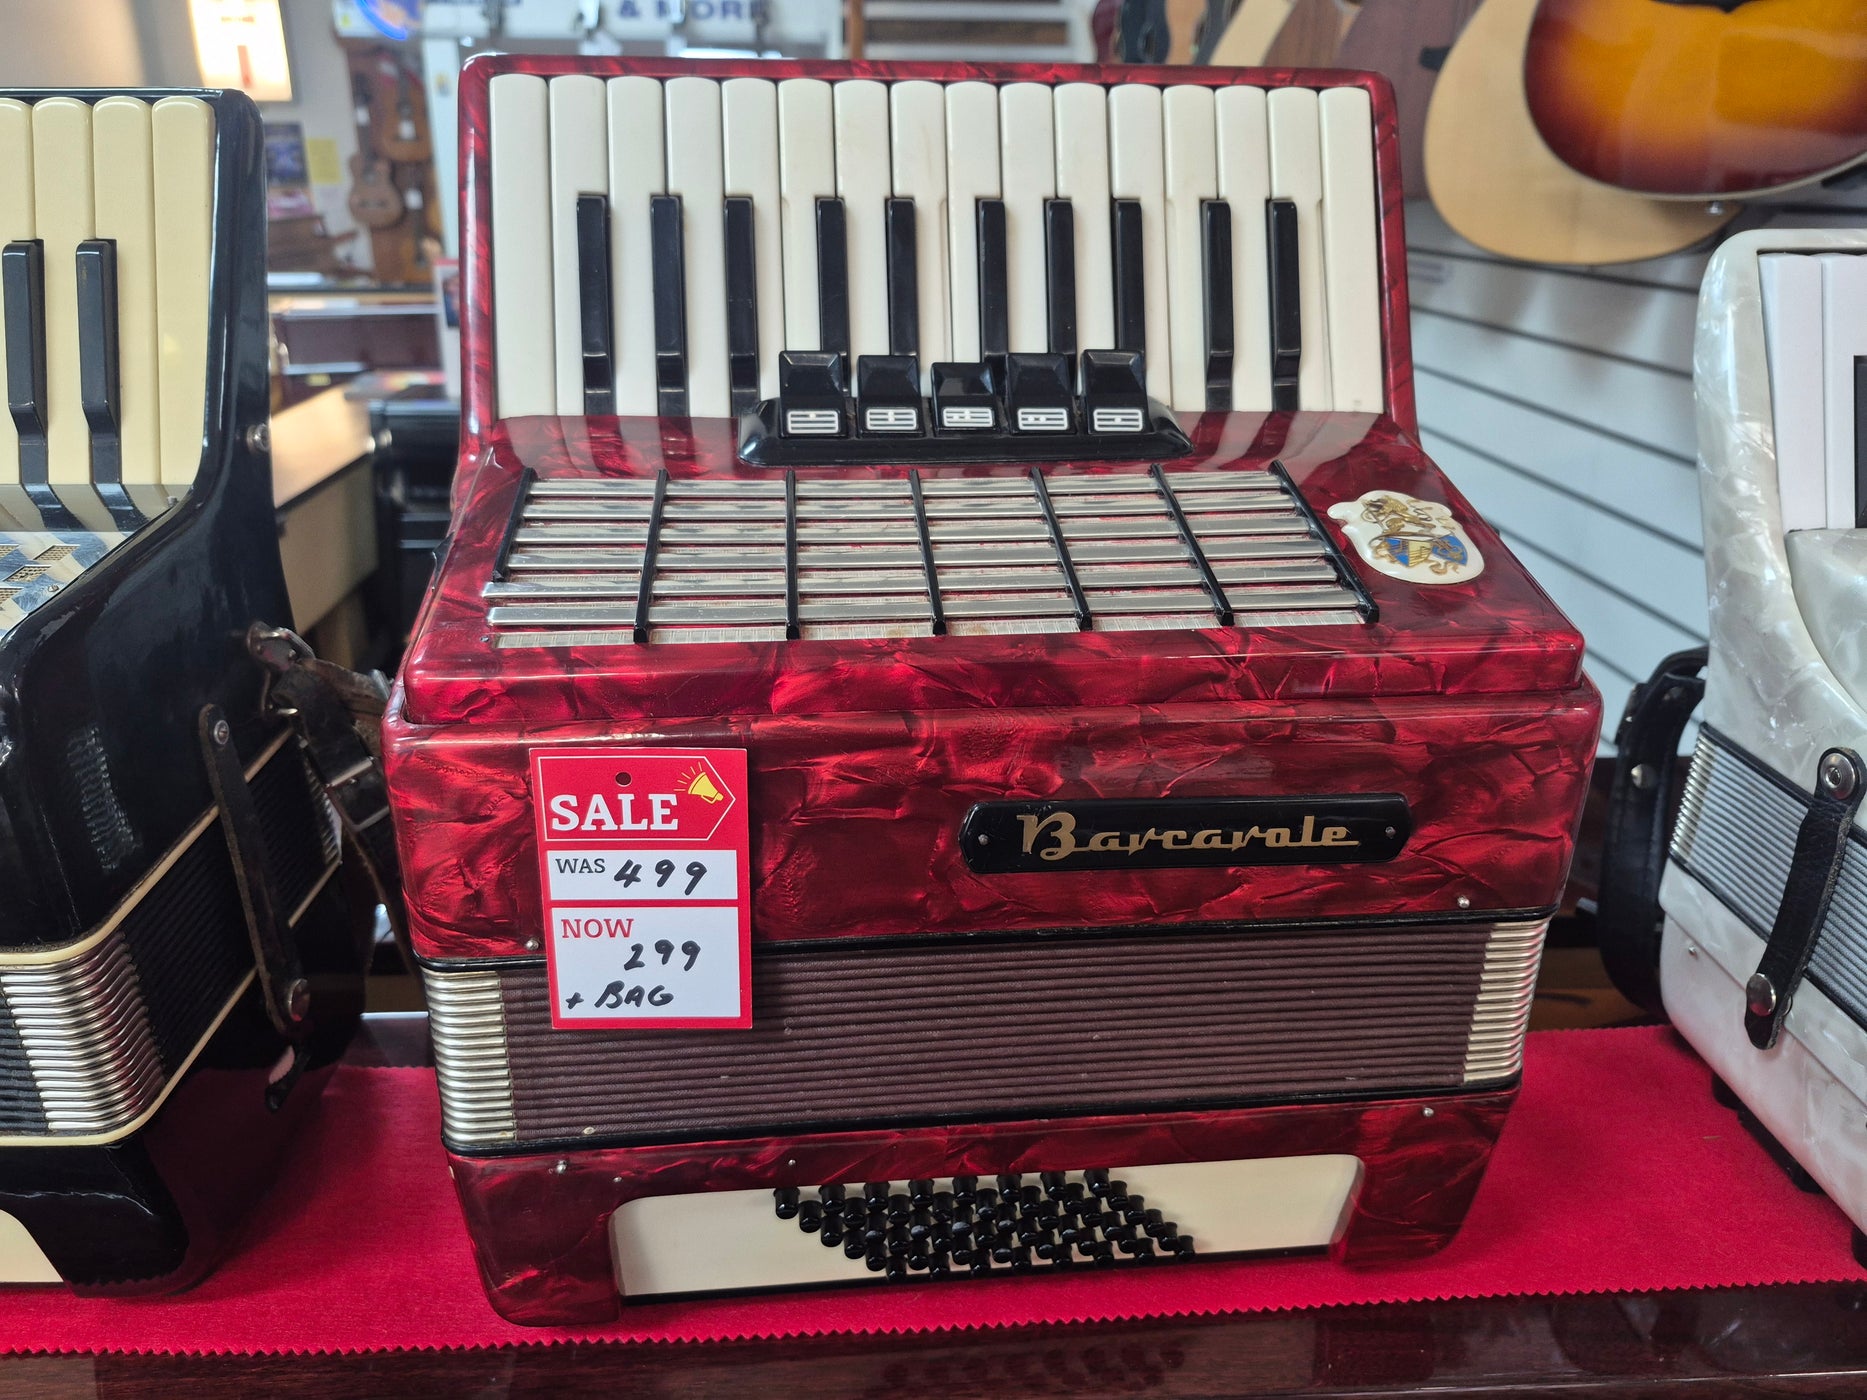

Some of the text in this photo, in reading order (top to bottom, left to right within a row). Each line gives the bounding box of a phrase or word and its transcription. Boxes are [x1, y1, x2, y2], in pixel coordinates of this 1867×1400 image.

[551, 794, 679, 831] SALE
[1016, 811, 1359, 861] Barcarole
[555, 858, 707, 896] WAS 499
[561, 918, 634, 938] NOW
[623, 939, 701, 971] 299
[565, 980, 674, 1009] + BAG
